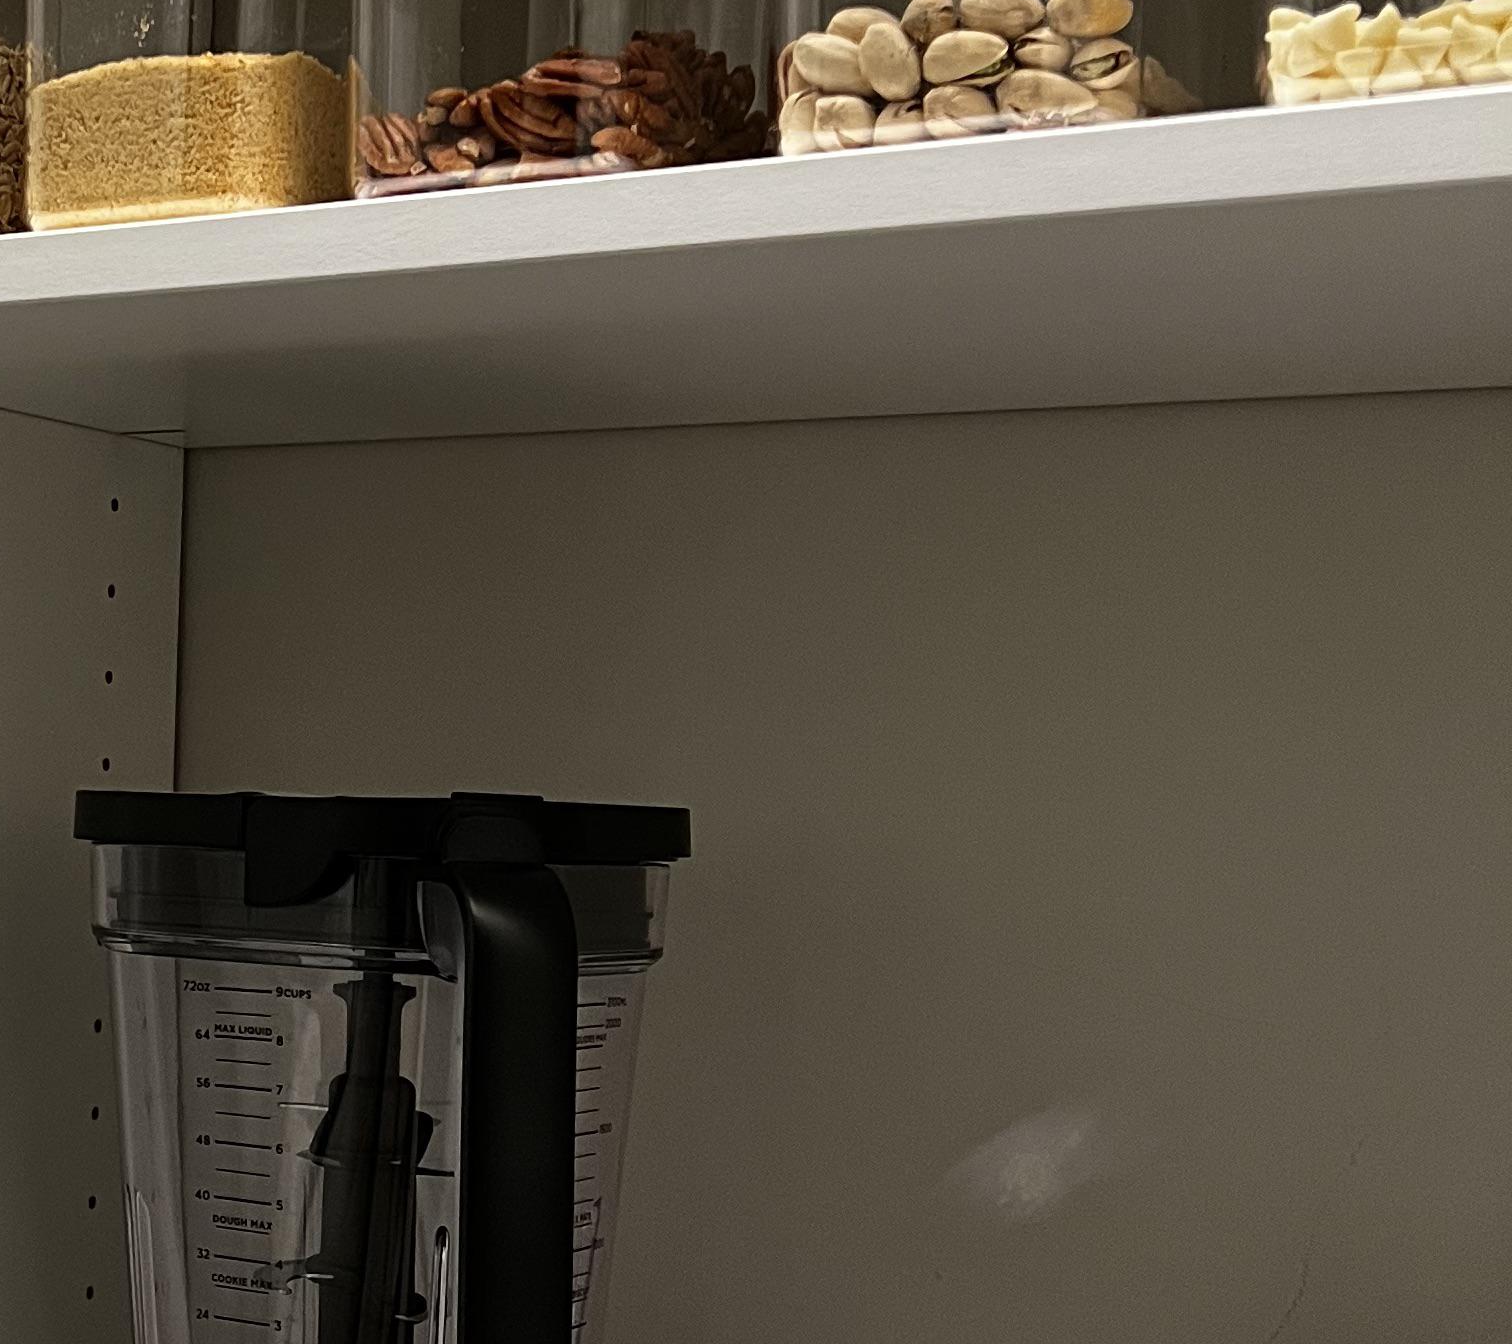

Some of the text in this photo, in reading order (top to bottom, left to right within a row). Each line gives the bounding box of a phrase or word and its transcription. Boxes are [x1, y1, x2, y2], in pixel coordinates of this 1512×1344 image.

[195, 1029, 210, 1040] 64
[214, 1023, 273, 1036] MAX LIQUID
[275, 1035, 284, 1046] 8
[196, 1077, 210, 1088] 56
[276, 1085, 283, 1095] 7
[196, 1134, 211, 1146] 48
[276, 1143, 284, 1154] 6
[195, 1190, 210, 1201] 40
[276, 1199, 284, 1210] 5
[212, 1214, 273, 1231] DOUGH MAX
[196, 1247, 210, 1260] 32
[275, 1259, 284, 1270] 4
[211, 1273, 273, 1290] COOKIE MAX
[196, 1308, 209, 1319] 24
[274, 1320, 282, 1331] 3
